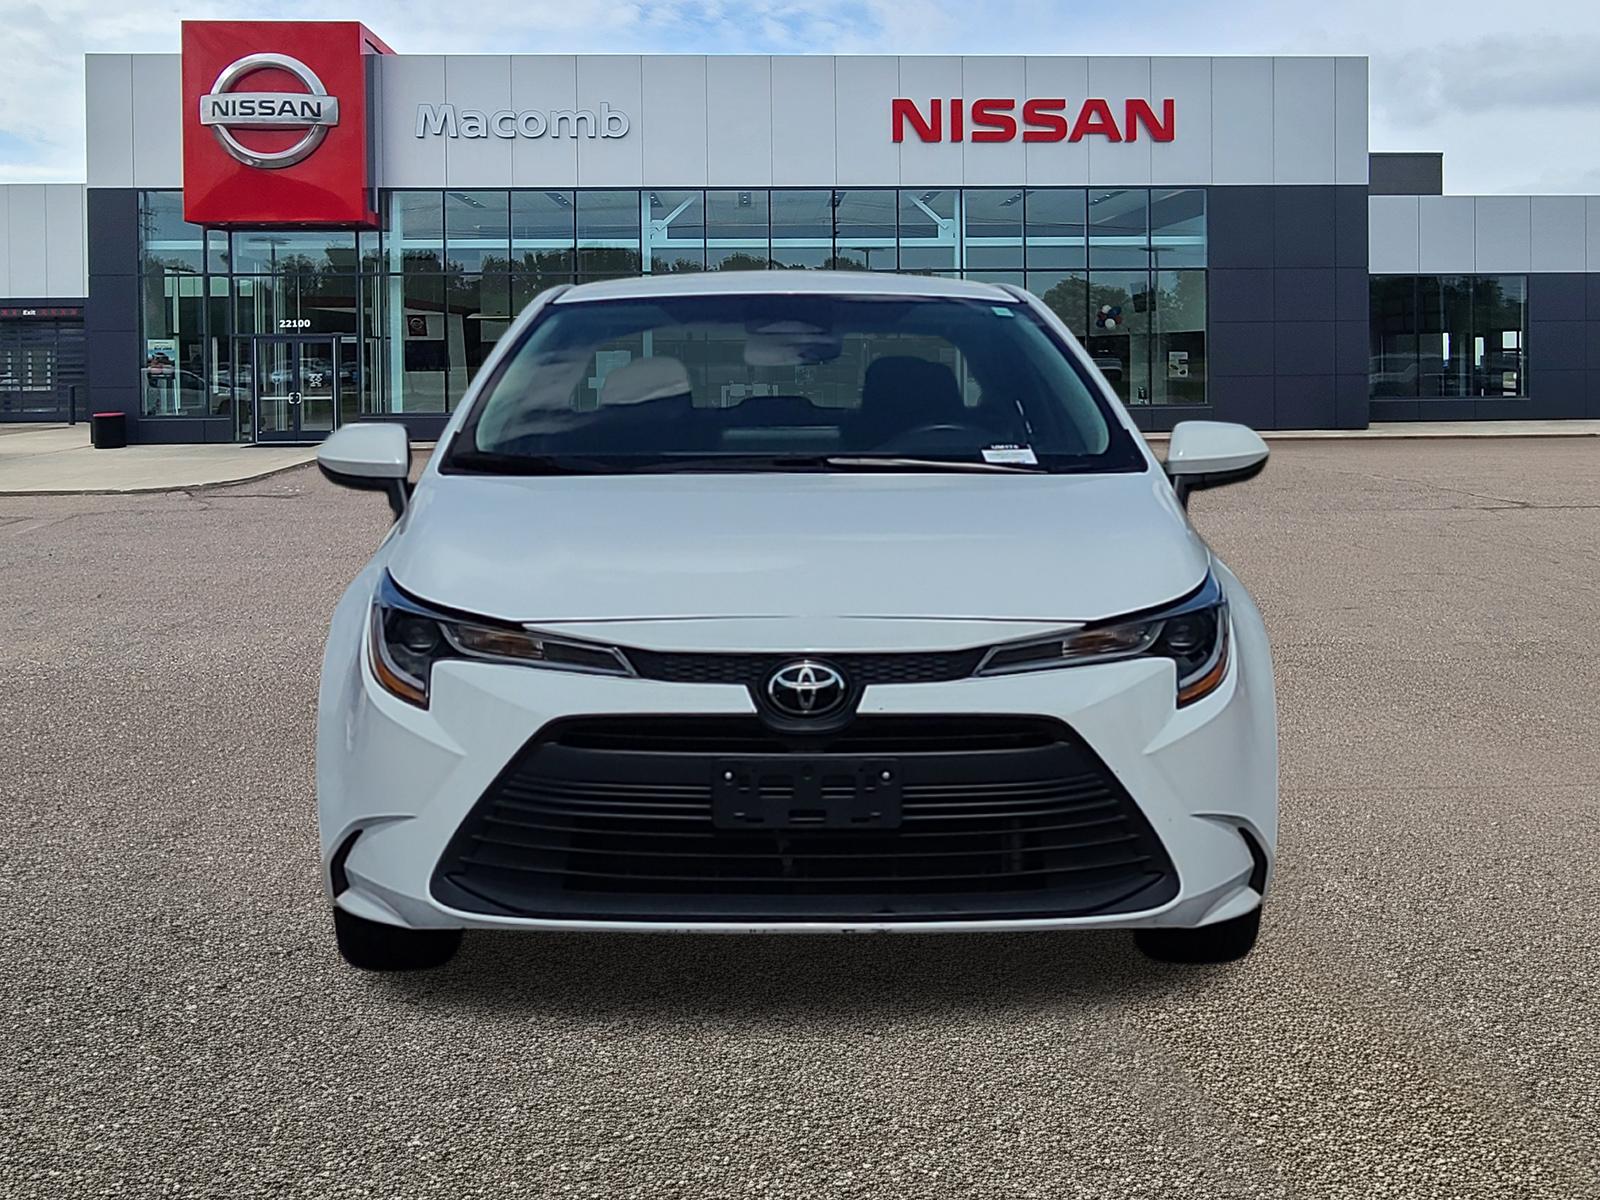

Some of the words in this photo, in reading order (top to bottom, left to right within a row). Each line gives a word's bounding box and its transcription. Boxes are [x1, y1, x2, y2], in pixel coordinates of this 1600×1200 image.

[211, 100, 321, 118] NISSAN
[415, 102, 630, 138] Macomb
[892, 98, 1175, 142] NISSAN
[279, 319, 311, 328] 22100
